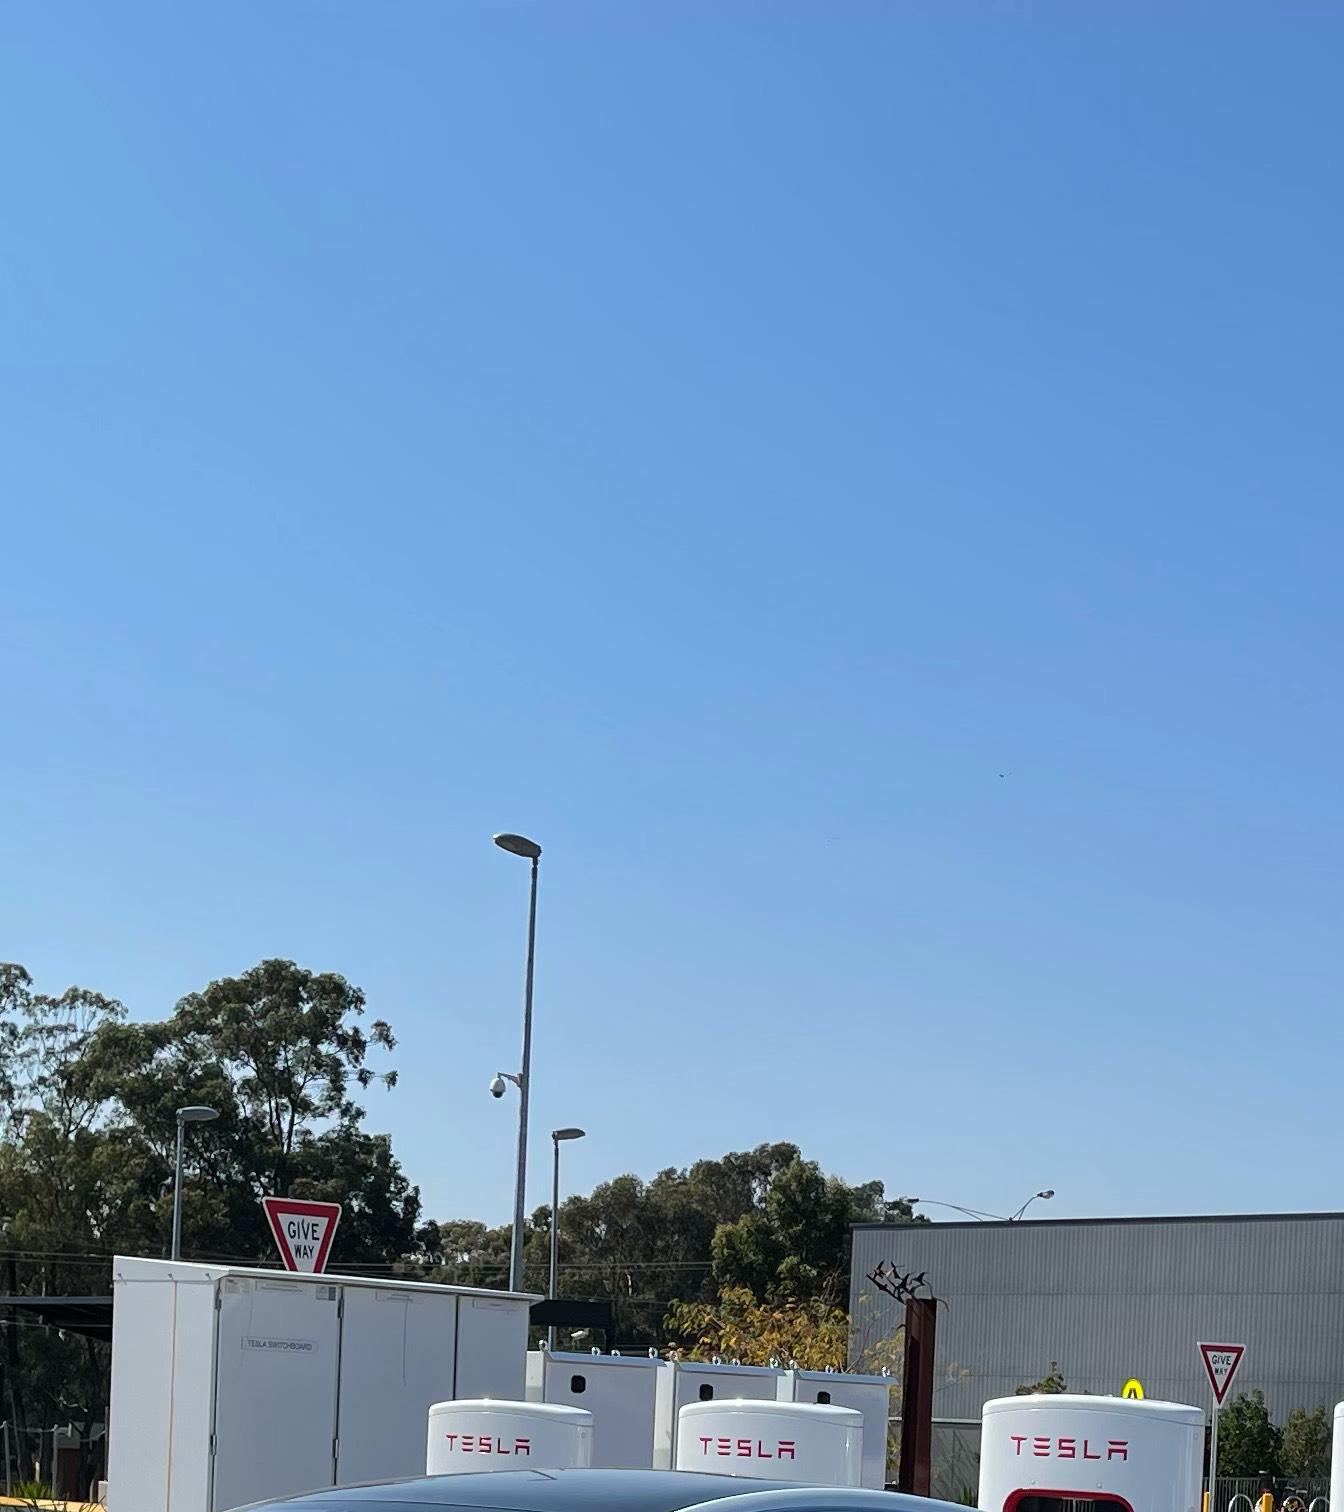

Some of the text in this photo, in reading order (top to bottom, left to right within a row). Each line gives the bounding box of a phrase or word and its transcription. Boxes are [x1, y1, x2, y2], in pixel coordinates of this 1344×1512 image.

[287, 1219, 320, 1241] GIVE
[294, 1245, 315, 1259] WAY
[248, 1340, 313, 1351] TESLA SWITCHBOARD
[1212, 1355, 1231, 1365] GIVE
[445, 1434, 531, 1456] TESLA
[698, 1436, 797, 1461] TESLA
[1010, 1435, 1130, 1463] TESLA
